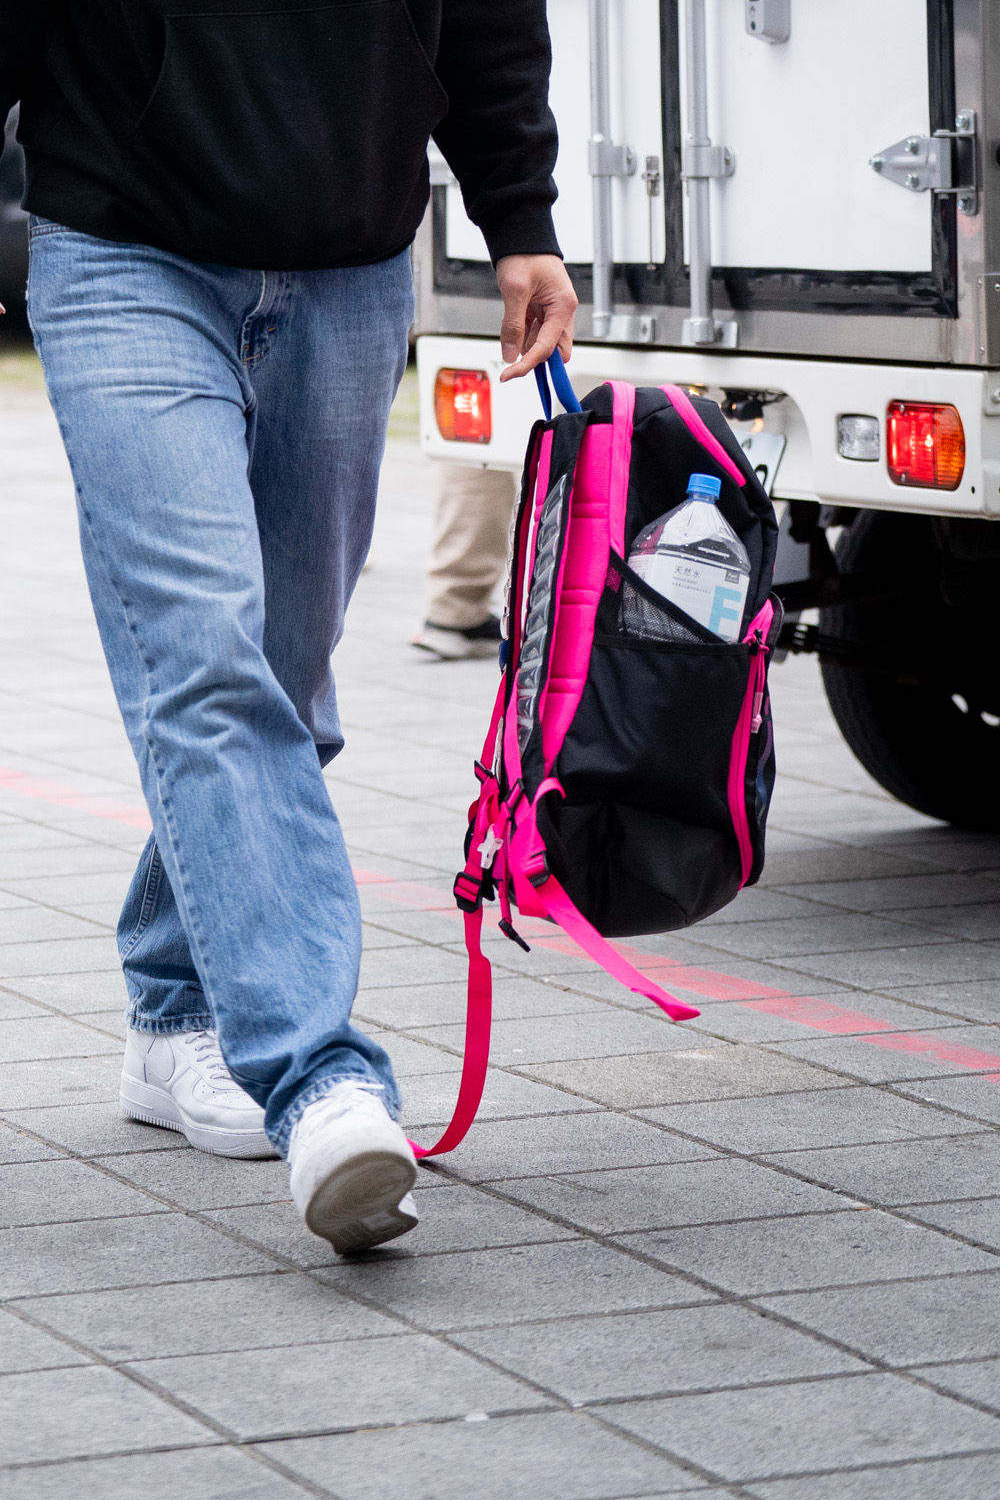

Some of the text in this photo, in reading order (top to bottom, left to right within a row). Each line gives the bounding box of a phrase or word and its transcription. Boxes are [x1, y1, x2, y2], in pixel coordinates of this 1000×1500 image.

[674, 565, 701, 579] 天然水
[708, 585, 742, 633] F
